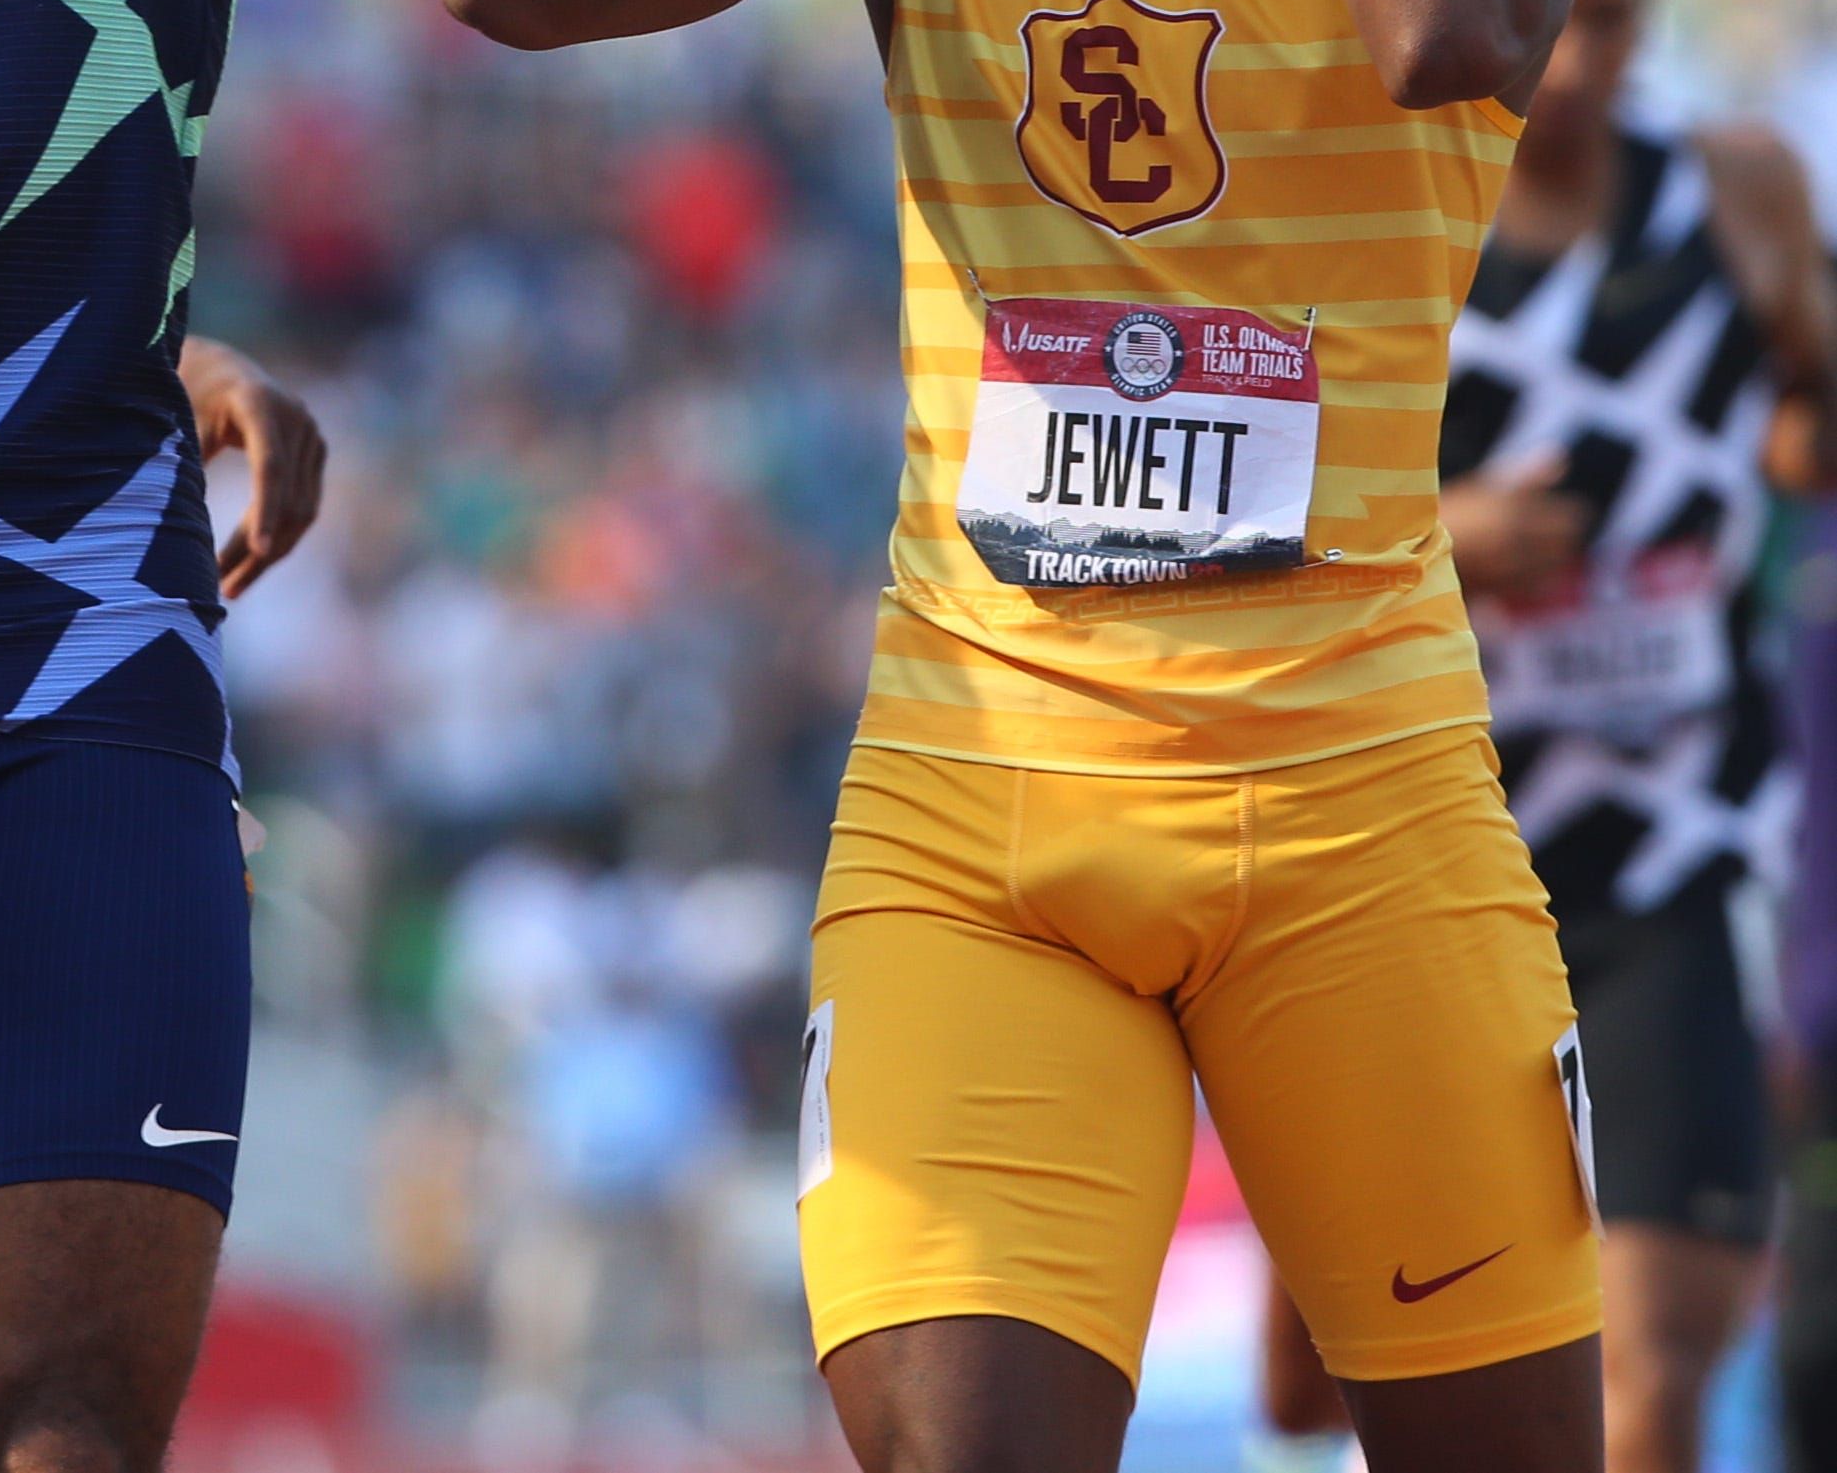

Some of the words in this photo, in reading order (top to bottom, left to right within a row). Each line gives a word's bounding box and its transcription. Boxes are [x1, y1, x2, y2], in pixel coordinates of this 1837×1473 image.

[1027, 333, 1092, 353] USATF
[1203, 324, 1234, 348] U.S.
[1202, 349, 1245, 374] TEAM
[1250, 352, 1304, 380] TRIALS
[1026, 411, 1248, 515] JEWETT
